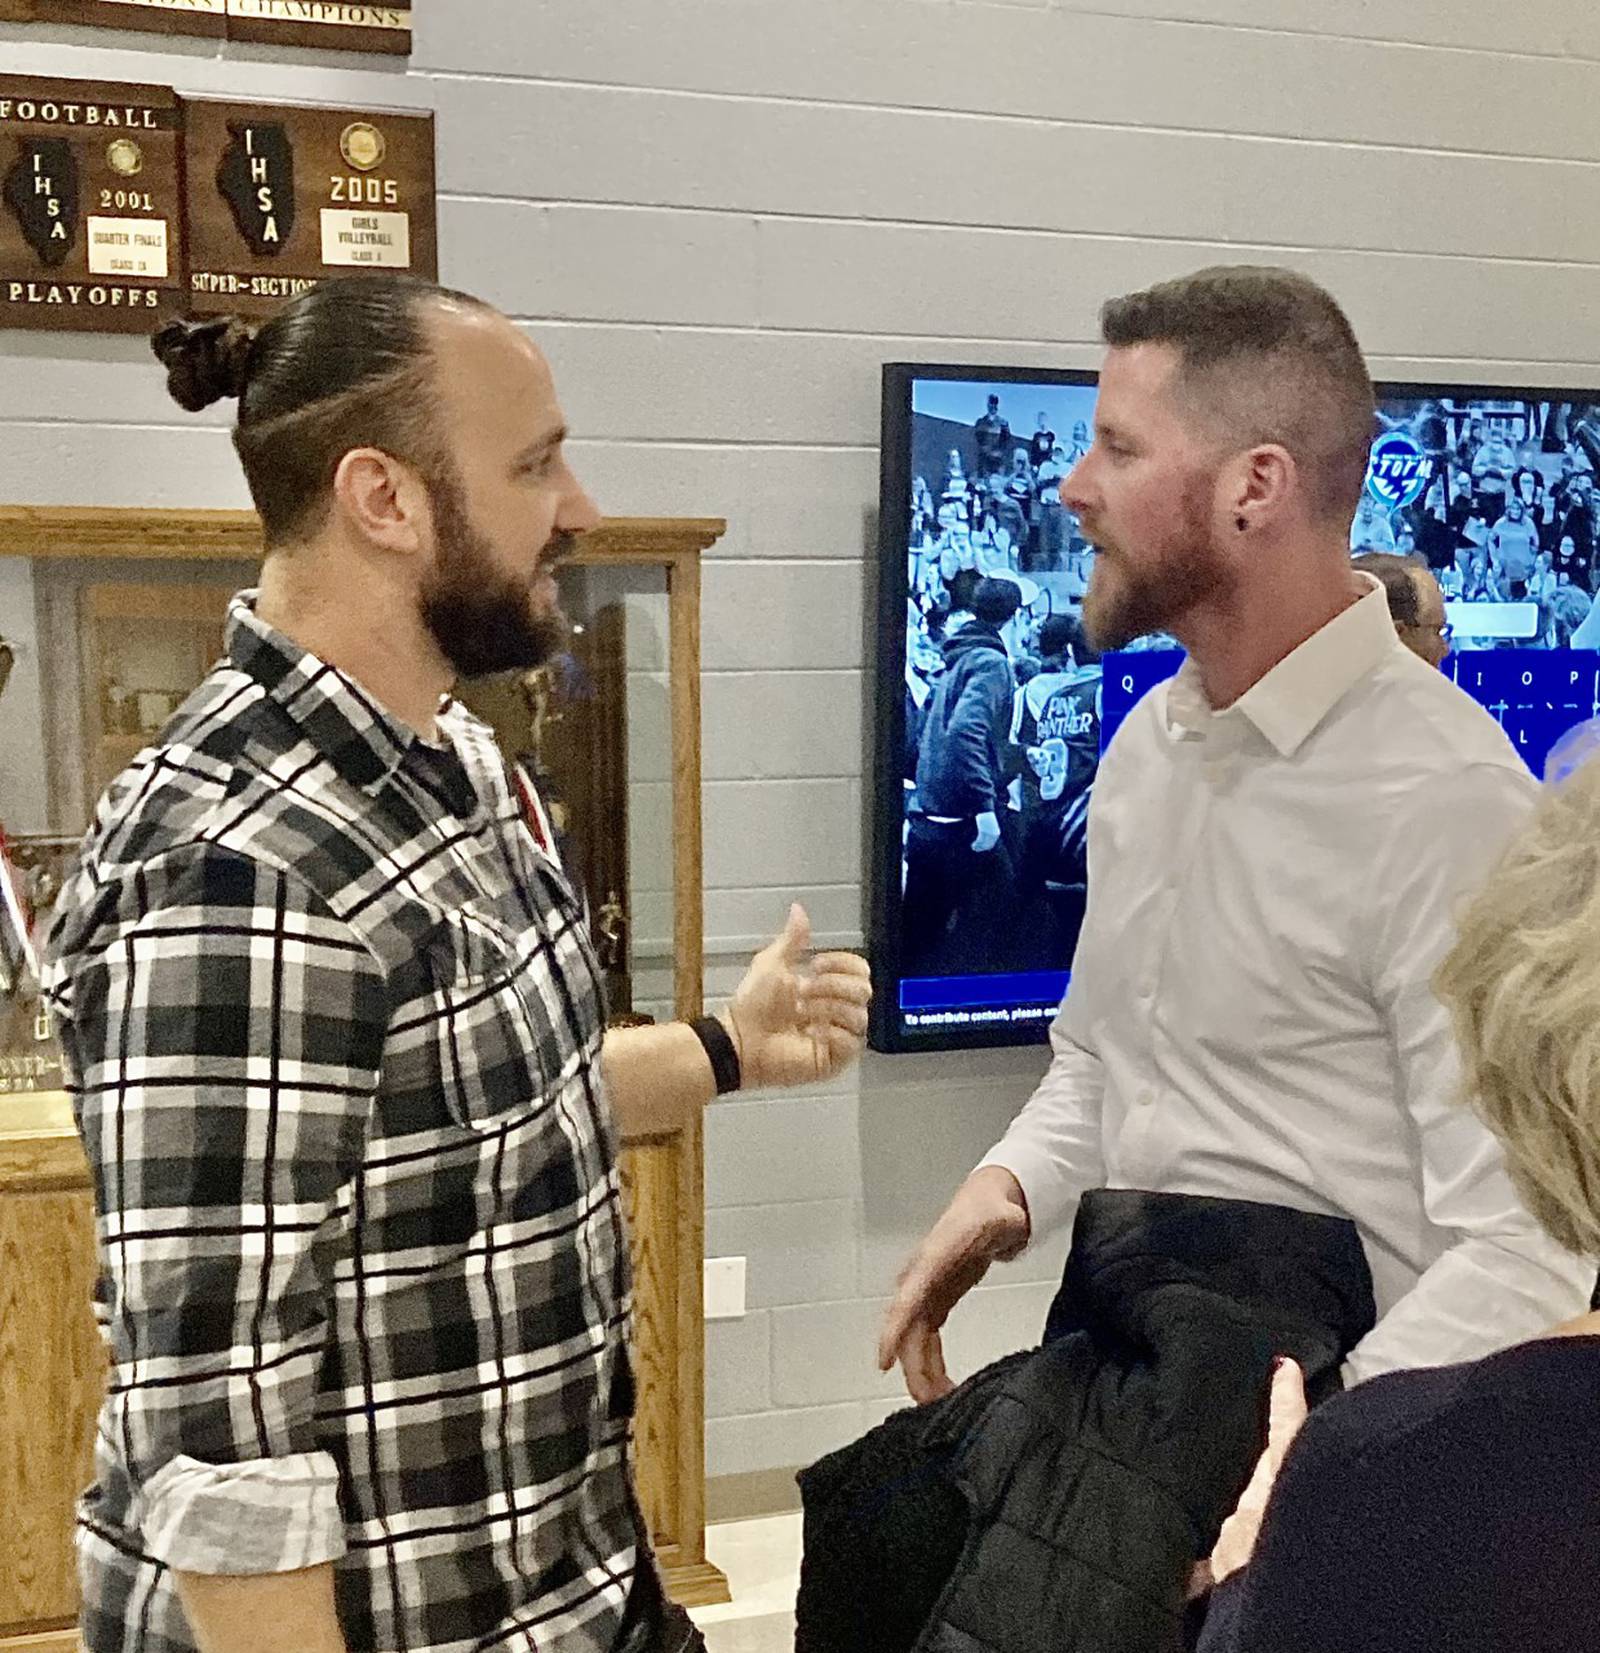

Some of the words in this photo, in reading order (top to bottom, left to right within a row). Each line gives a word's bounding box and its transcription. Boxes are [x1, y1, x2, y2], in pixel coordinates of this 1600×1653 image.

[239, 0, 400, 26] CHAMPIONS
[0, 101, 157, 128] FOOTBALL
[246, 129, 279, 242] IHSA
[330, 175, 398, 204] 2005
[100, 189, 154, 211] 2001
[352, 217, 378, 230] GIRLS
[338, 231, 393, 247] VOLLEYBALL
[10, 283, 158, 307] PLAYOFFS
[1121, 675, 1133, 694] Q
[1521, 671, 1533, 686] O
[1570, 671, 1579, 685] P
[1520, 729, 1528, 744] L
